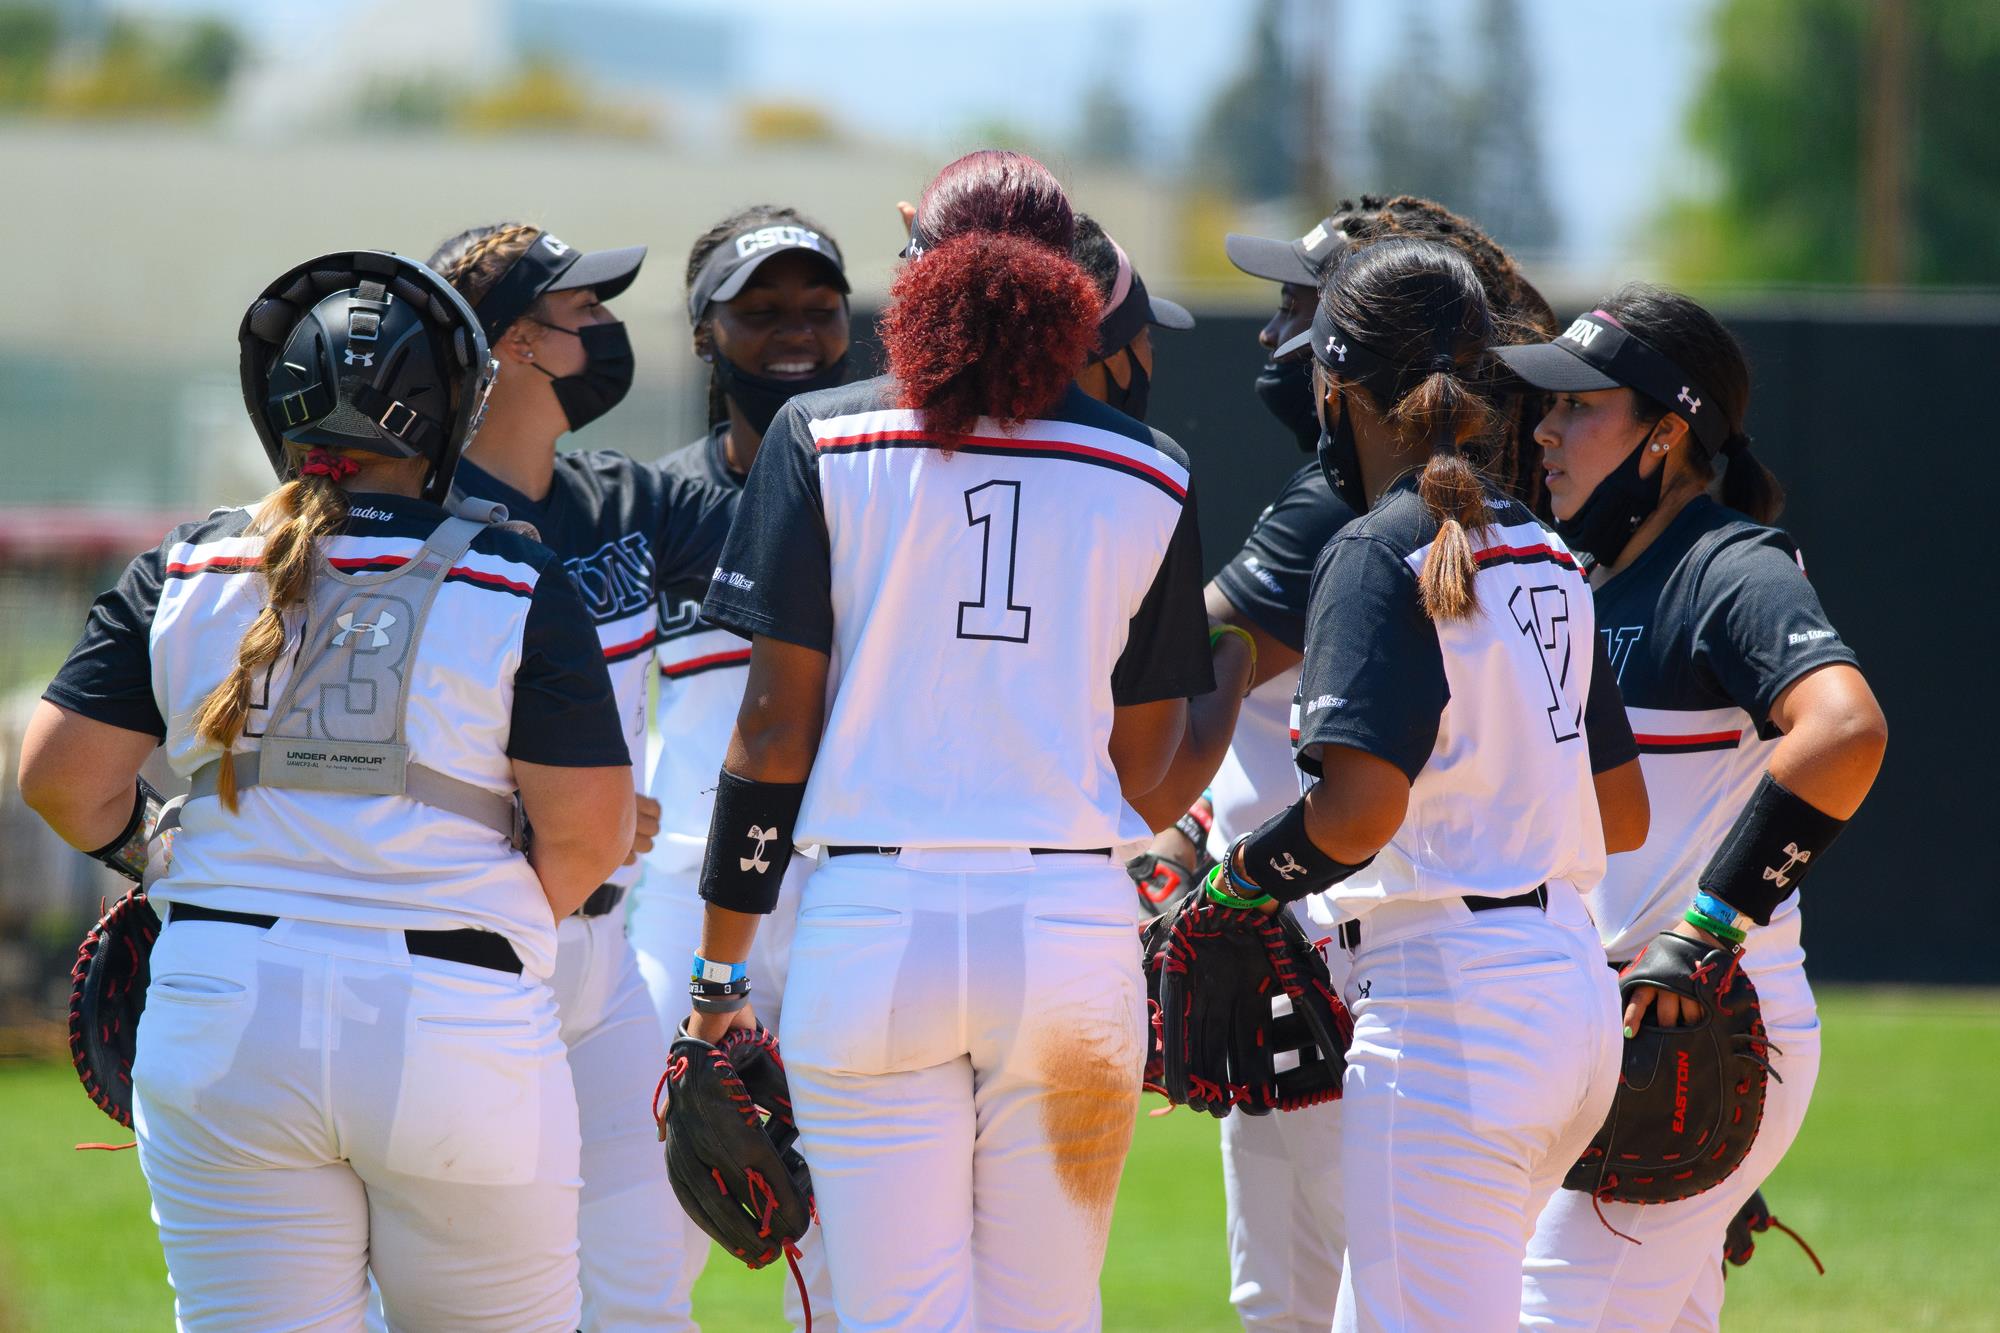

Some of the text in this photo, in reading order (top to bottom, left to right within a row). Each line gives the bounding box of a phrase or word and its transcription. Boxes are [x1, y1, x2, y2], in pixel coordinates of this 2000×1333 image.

[956, 479, 1031, 643] 1
[287, 751, 327, 761] UNDER
[1672, 1050, 1689, 1134] EASTON
